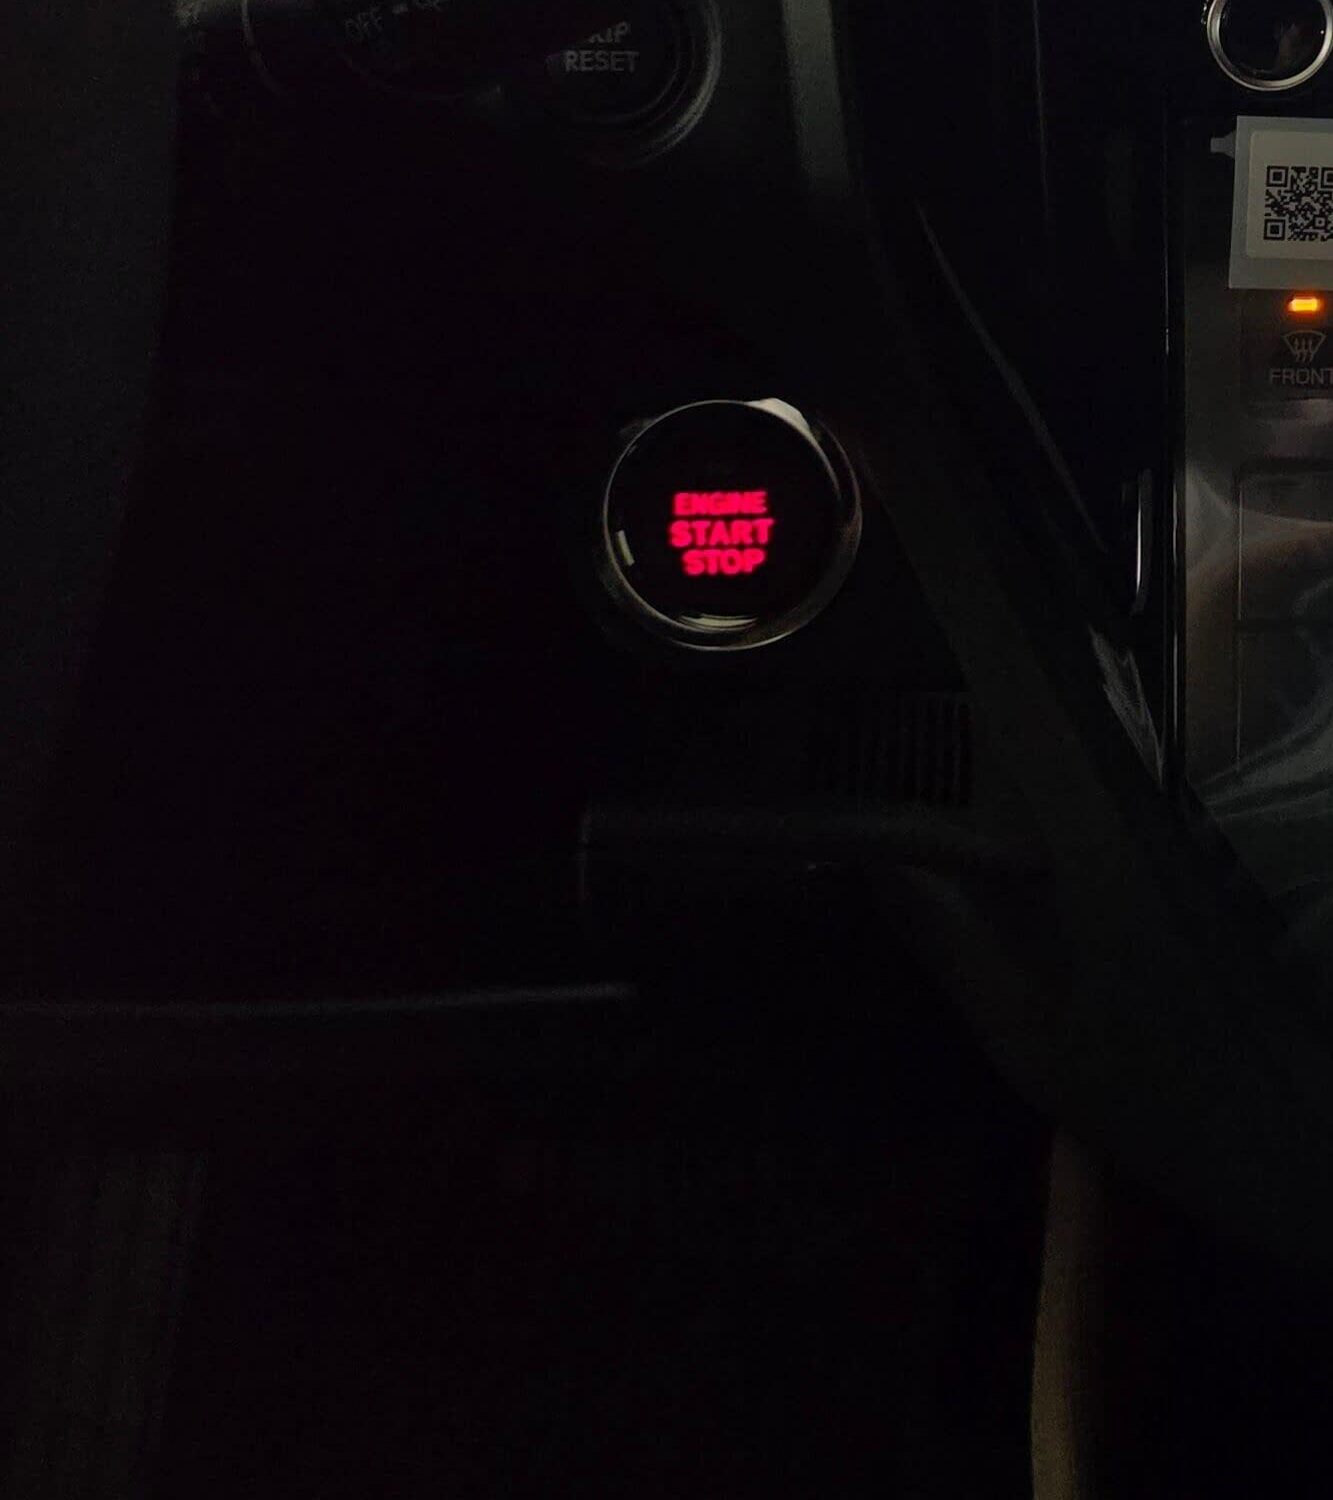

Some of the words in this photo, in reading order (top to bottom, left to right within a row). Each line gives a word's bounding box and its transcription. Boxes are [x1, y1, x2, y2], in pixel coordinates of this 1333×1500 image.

[564, 50, 641, 73] RESET
[674, 490, 768, 516] ENGINE
[670, 518, 775, 548] START
[682, 548, 766, 576] STOP
